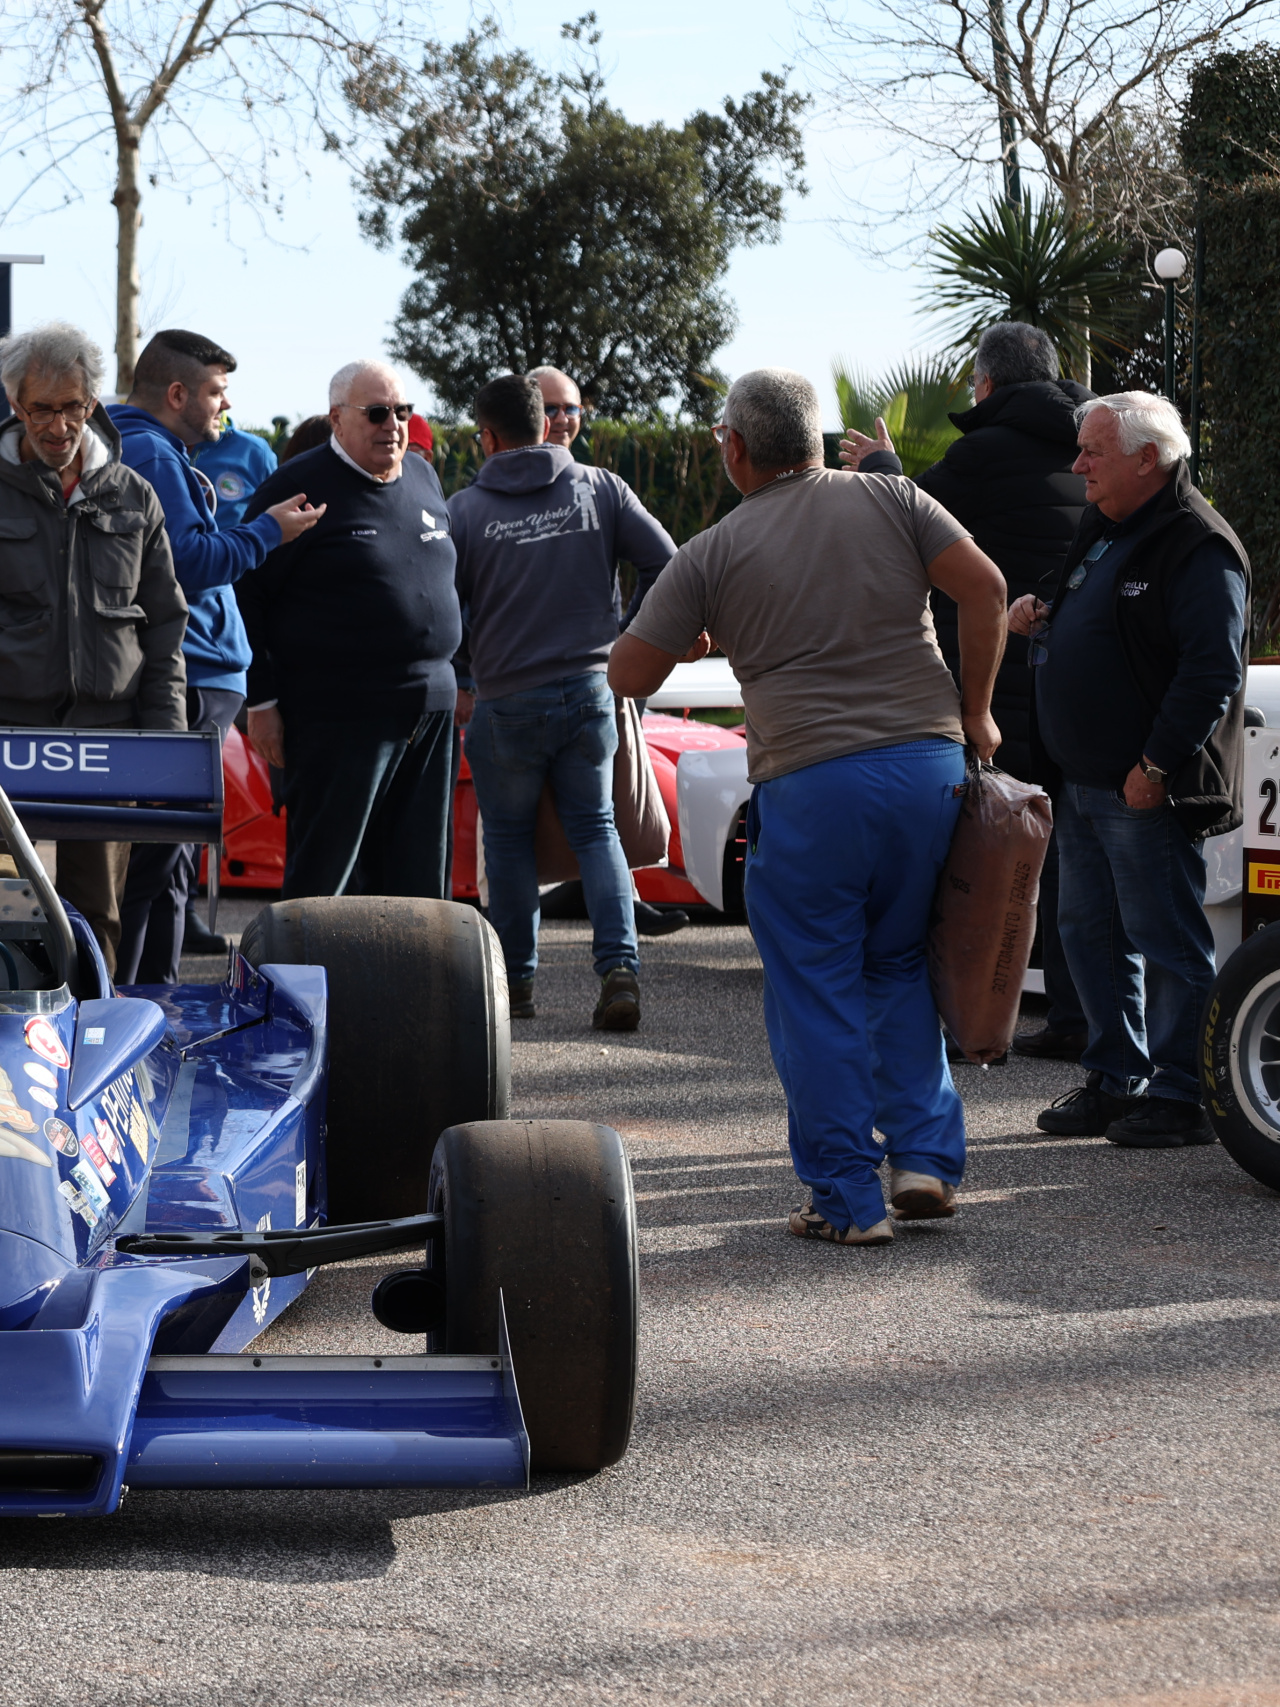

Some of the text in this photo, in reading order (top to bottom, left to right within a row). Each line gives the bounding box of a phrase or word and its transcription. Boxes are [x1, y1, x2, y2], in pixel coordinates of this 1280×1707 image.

[525, 505, 571, 526] World
[1258, 776, 1280, 837] 2
[1203, 997, 1221, 1091] ZERO
